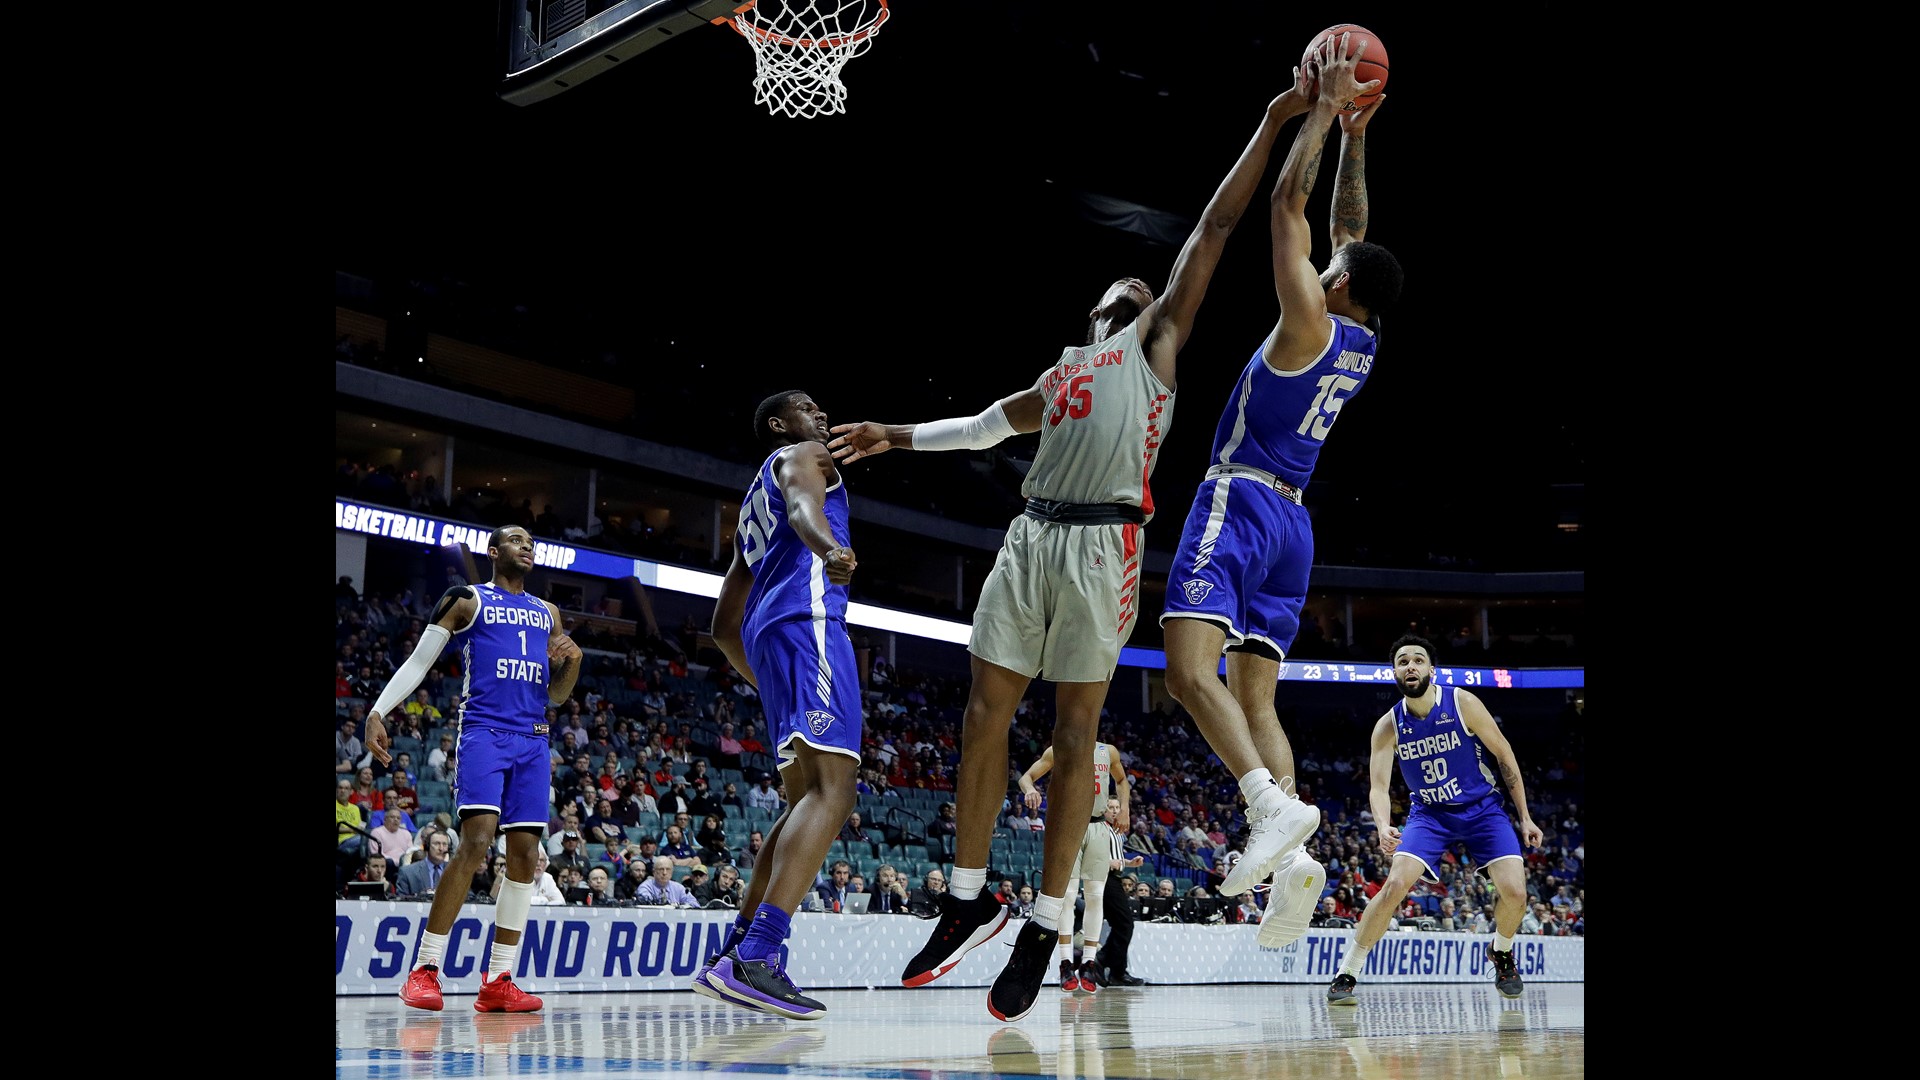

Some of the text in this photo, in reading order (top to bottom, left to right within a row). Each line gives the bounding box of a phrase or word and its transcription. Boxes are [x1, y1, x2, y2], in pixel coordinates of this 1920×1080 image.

[1043, 349, 1123, 397] HOUSON
[1049, 374, 1094, 427] 35
[1296, 373, 1360, 441] 15
[336, 501, 577, 570] ASKETBALL CHAMSHIP
[738, 487, 779, 568] 50
[483, 605, 551, 634] GEORGIA
[517, 630, 527, 656] 1
[496, 658, 543, 685] STATE
[1303, 665, 1322, 679] 23
[1333, 671, 1340, 681] 3
[1374, 668, 1396, 681] 4:0
[1465, 670, 1482, 685] 31
[1398, 730, 1462, 761] GEORGIA
[1421, 757, 1448, 784] 30
[1419, 776, 1463, 804] STATE
[368, 916, 590, 978] SCND
[603, 920, 792, 978] ROUN
[1306, 936, 1346, 976] THE
[1360, 938, 1465, 976] NIVERSITY
[1512, 941, 1545, 976] LSA
[1281, 956, 1296, 974] BY
